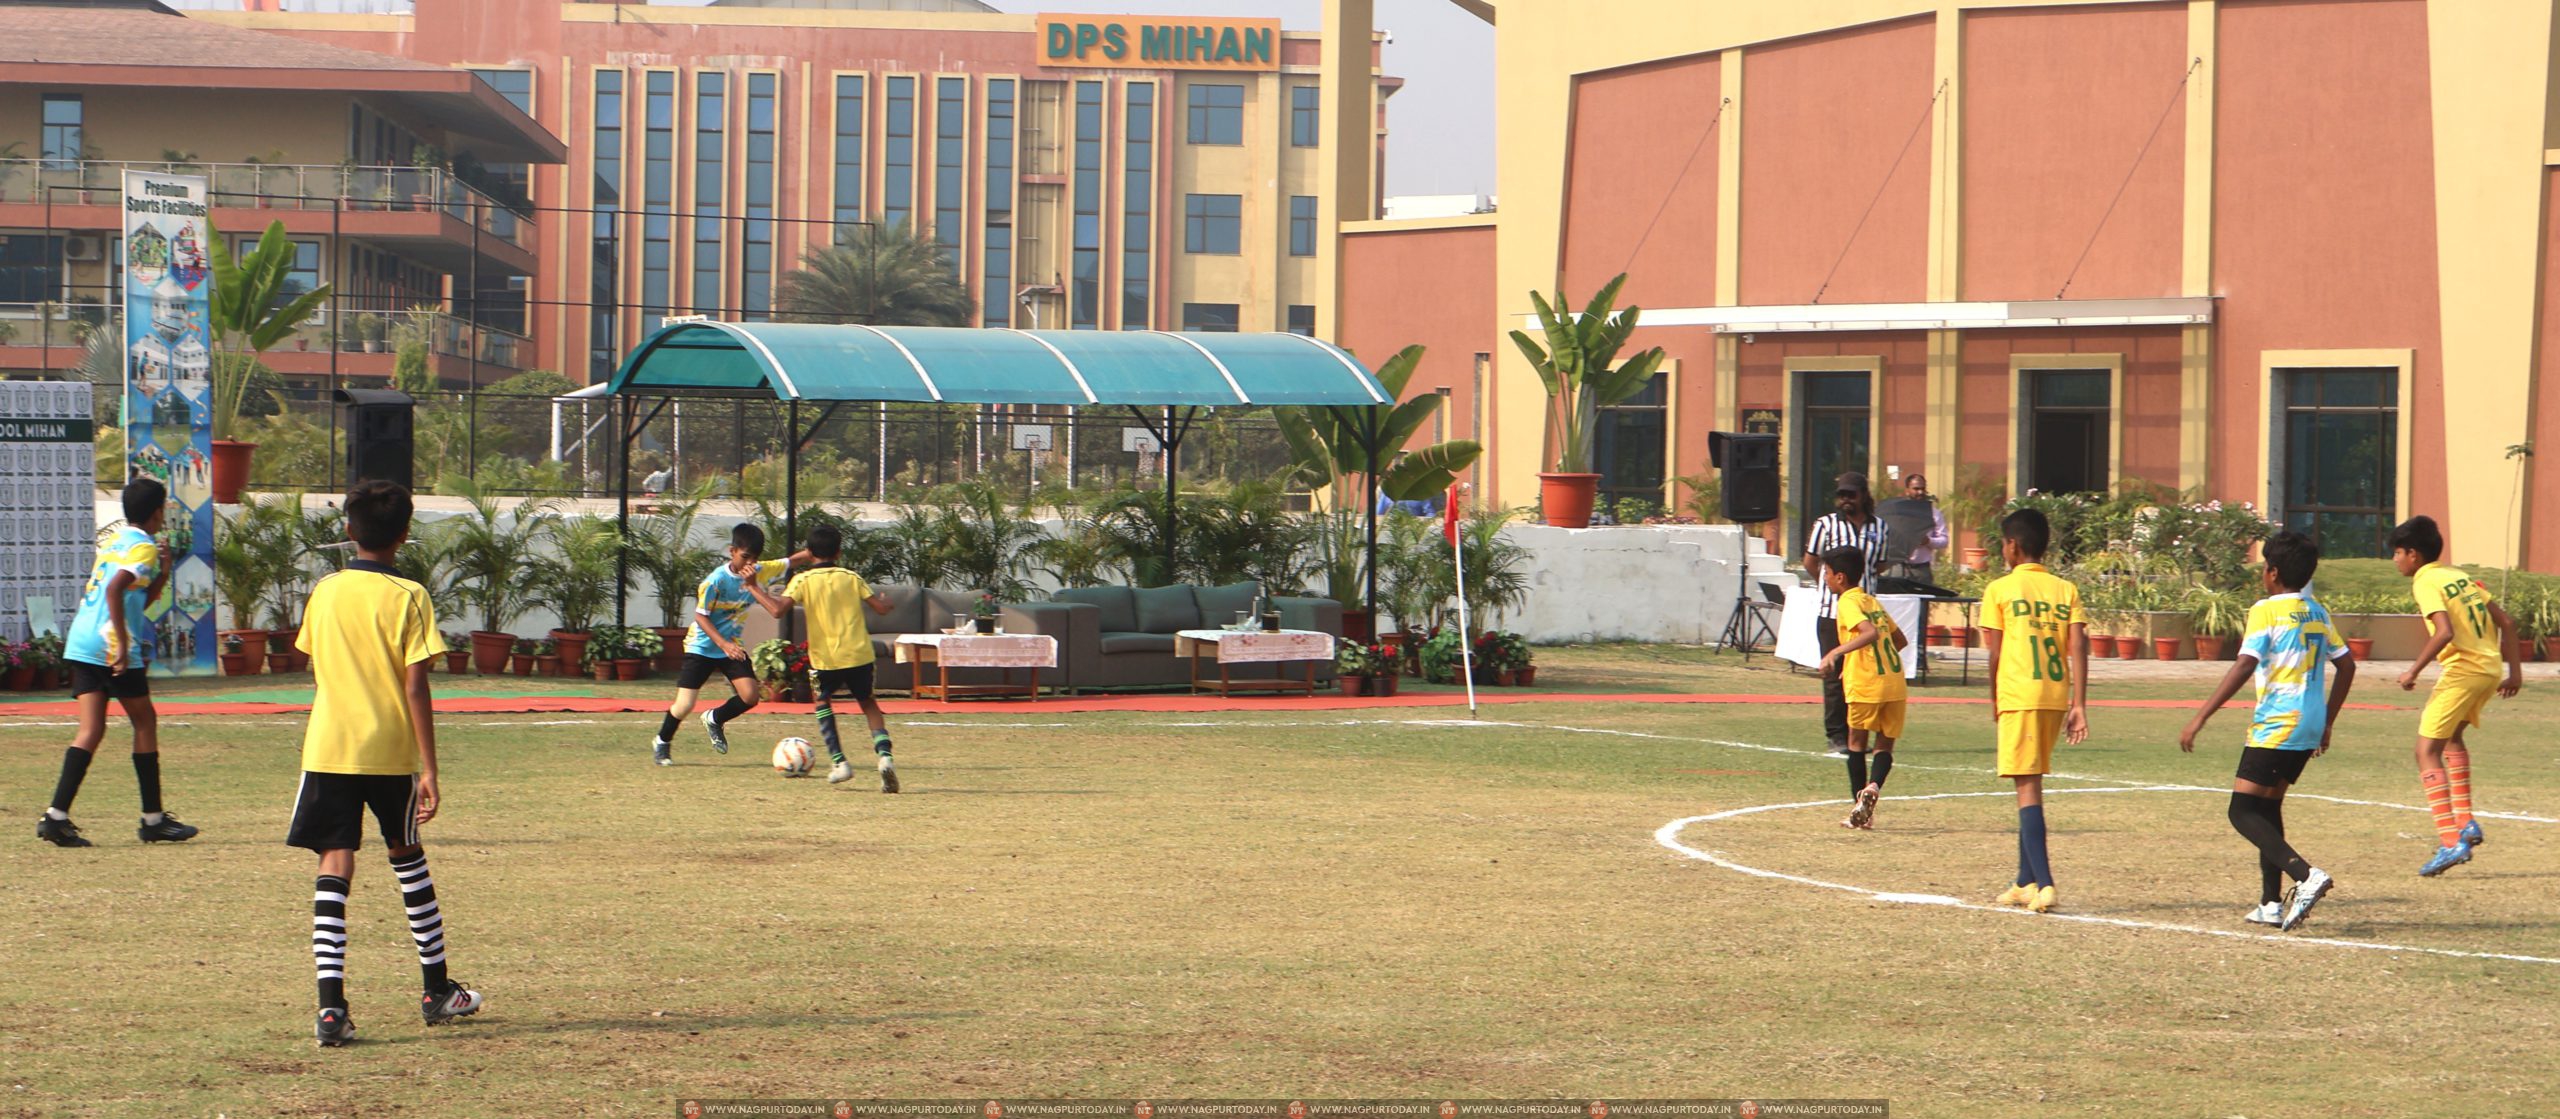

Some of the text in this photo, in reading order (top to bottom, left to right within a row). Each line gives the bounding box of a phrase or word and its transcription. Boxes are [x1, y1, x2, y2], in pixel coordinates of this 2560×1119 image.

[1047, 22, 1272, 63] DPS MIHAN
[144, 180, 189, 199] Premium
[127, 195, 207, 218] Sports Facilities
[25, 424, 66, 438] MIHAN
[2444, 579, 2477, 600] DP
[2012, 599, 2072, 621] DPS
[2467, 603, 2488, 639] 17
[1871, 637, 1902, 675] 10
[2029, 635, 2065, 682] 18
[2304, 632, 2325, 681] 7
